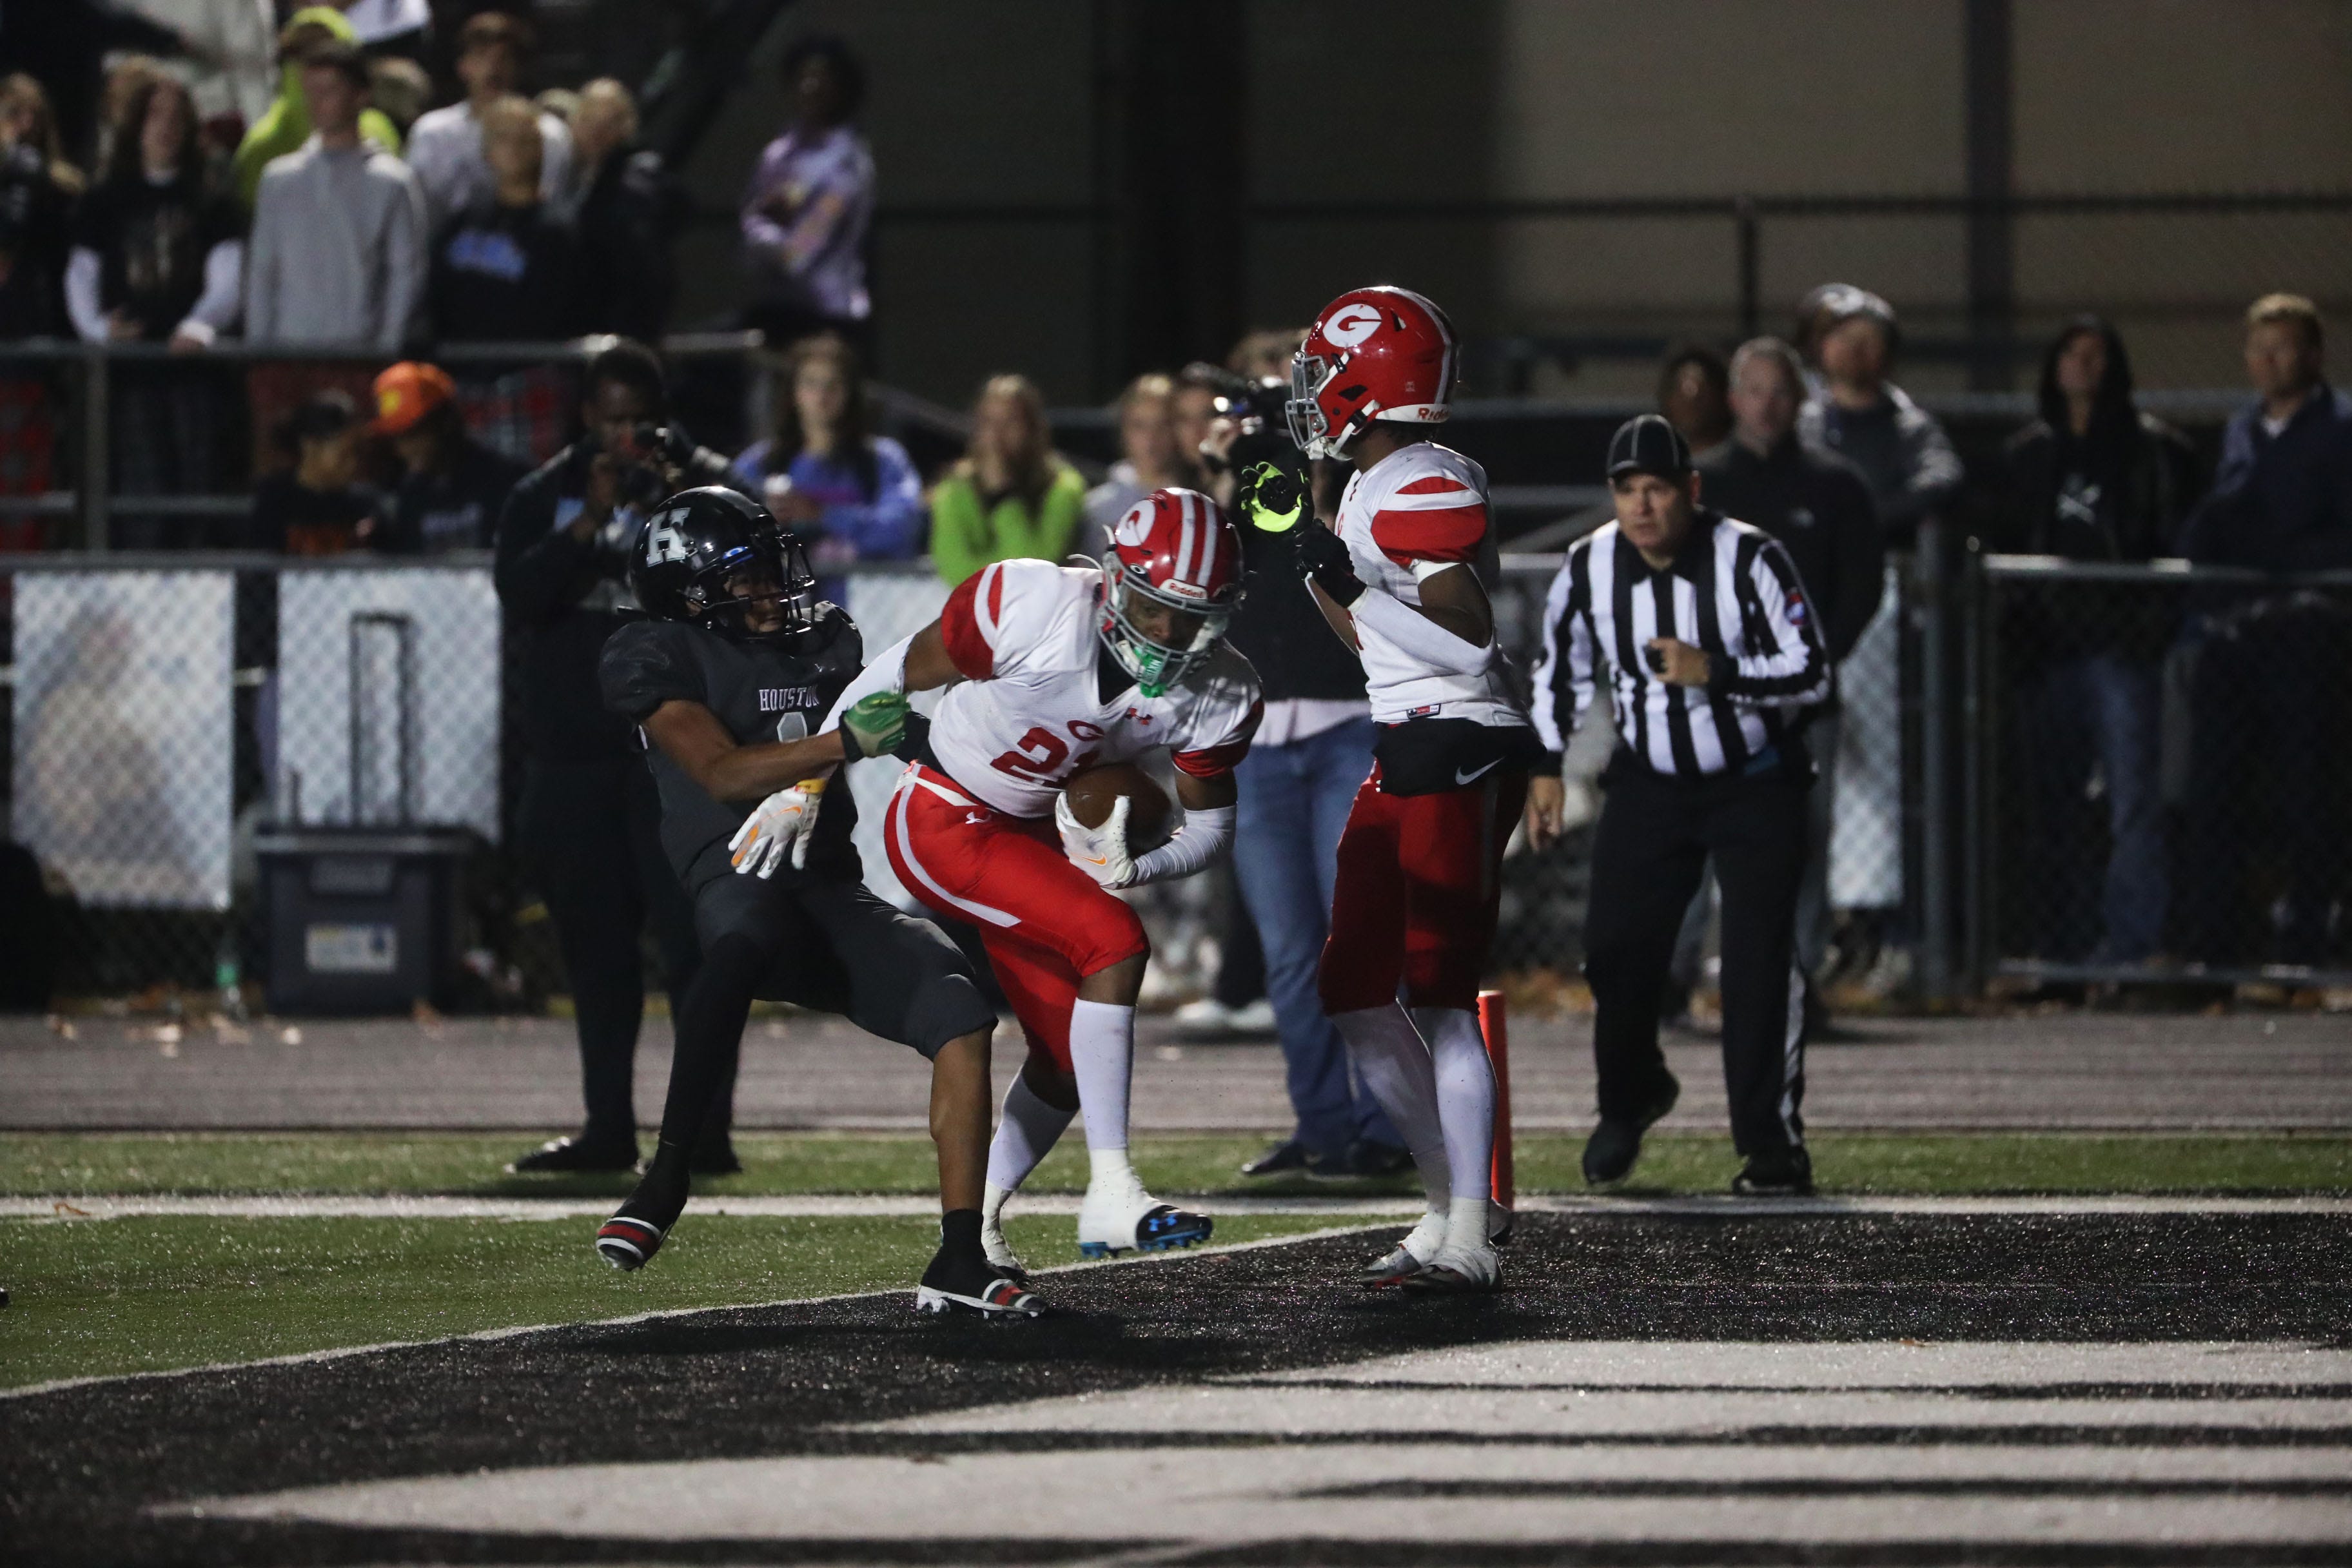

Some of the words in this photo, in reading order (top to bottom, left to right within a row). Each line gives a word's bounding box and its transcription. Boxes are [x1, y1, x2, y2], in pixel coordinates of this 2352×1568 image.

[1322, 303, 1382, 348] G
[647, 507, 691, 567] H
[1115, 500, 1155, 547] G
[1066, 720, 1105, 741] G
